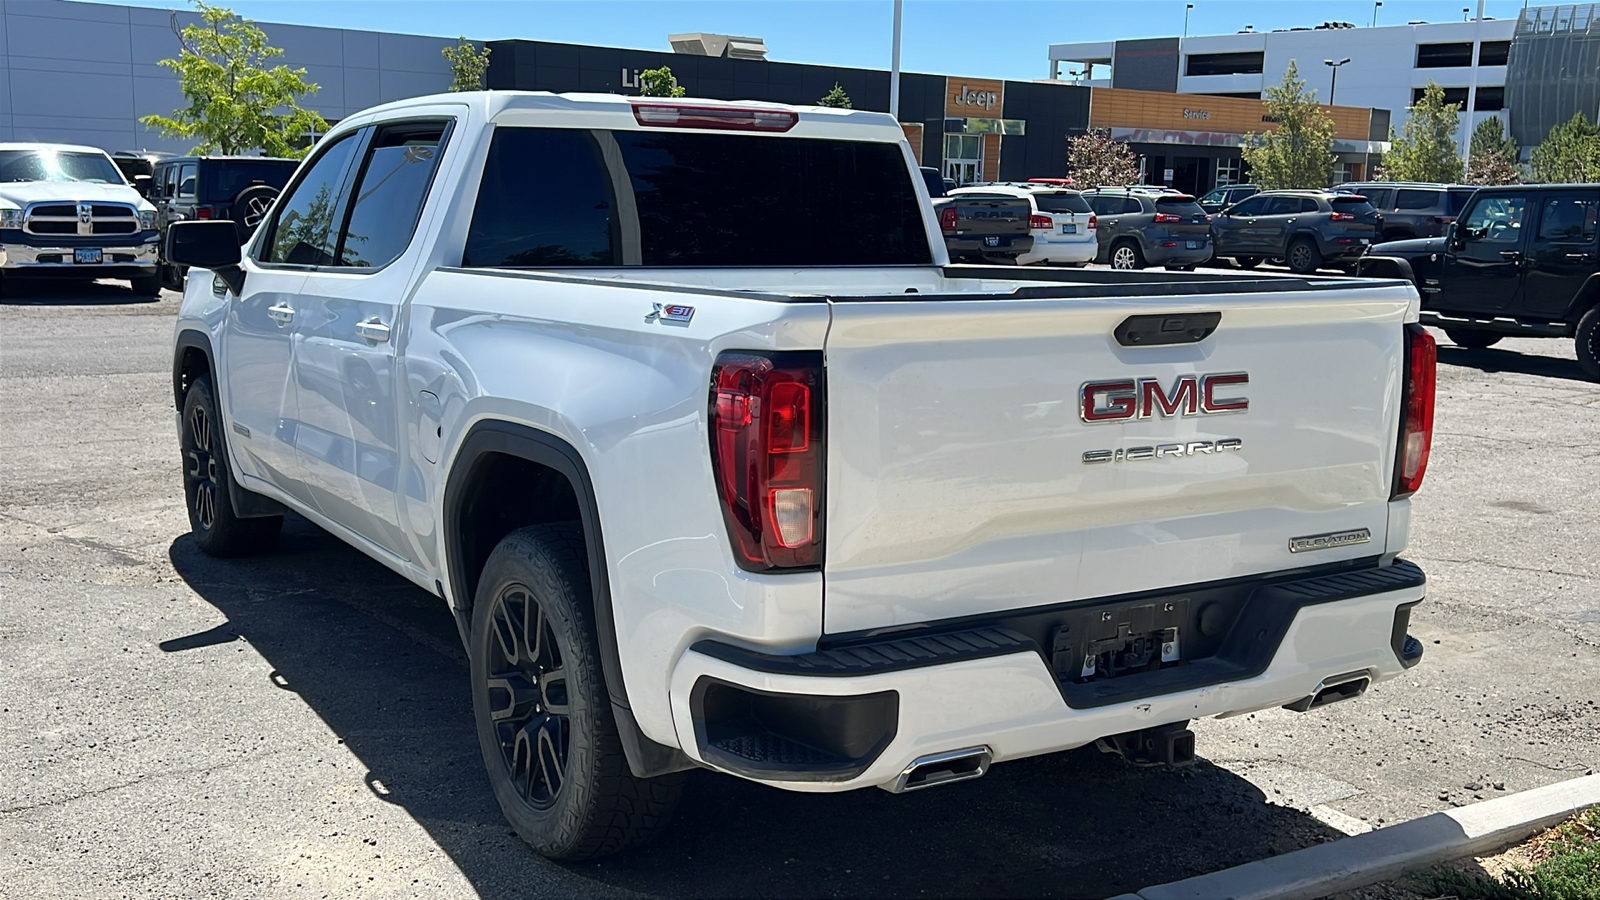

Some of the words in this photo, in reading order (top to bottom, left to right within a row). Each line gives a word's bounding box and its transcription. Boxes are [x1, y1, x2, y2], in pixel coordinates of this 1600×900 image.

[955, 85, 997, 110] Jeep
[1183, 108, 1211, 120] Service
[644, 301, 695, 322] X31
[1080, 372, 1249, 423] GMC
[1082, 438, 1242, 464] SIERRA
[1296, 532, 1366, 548] ELEVATION
